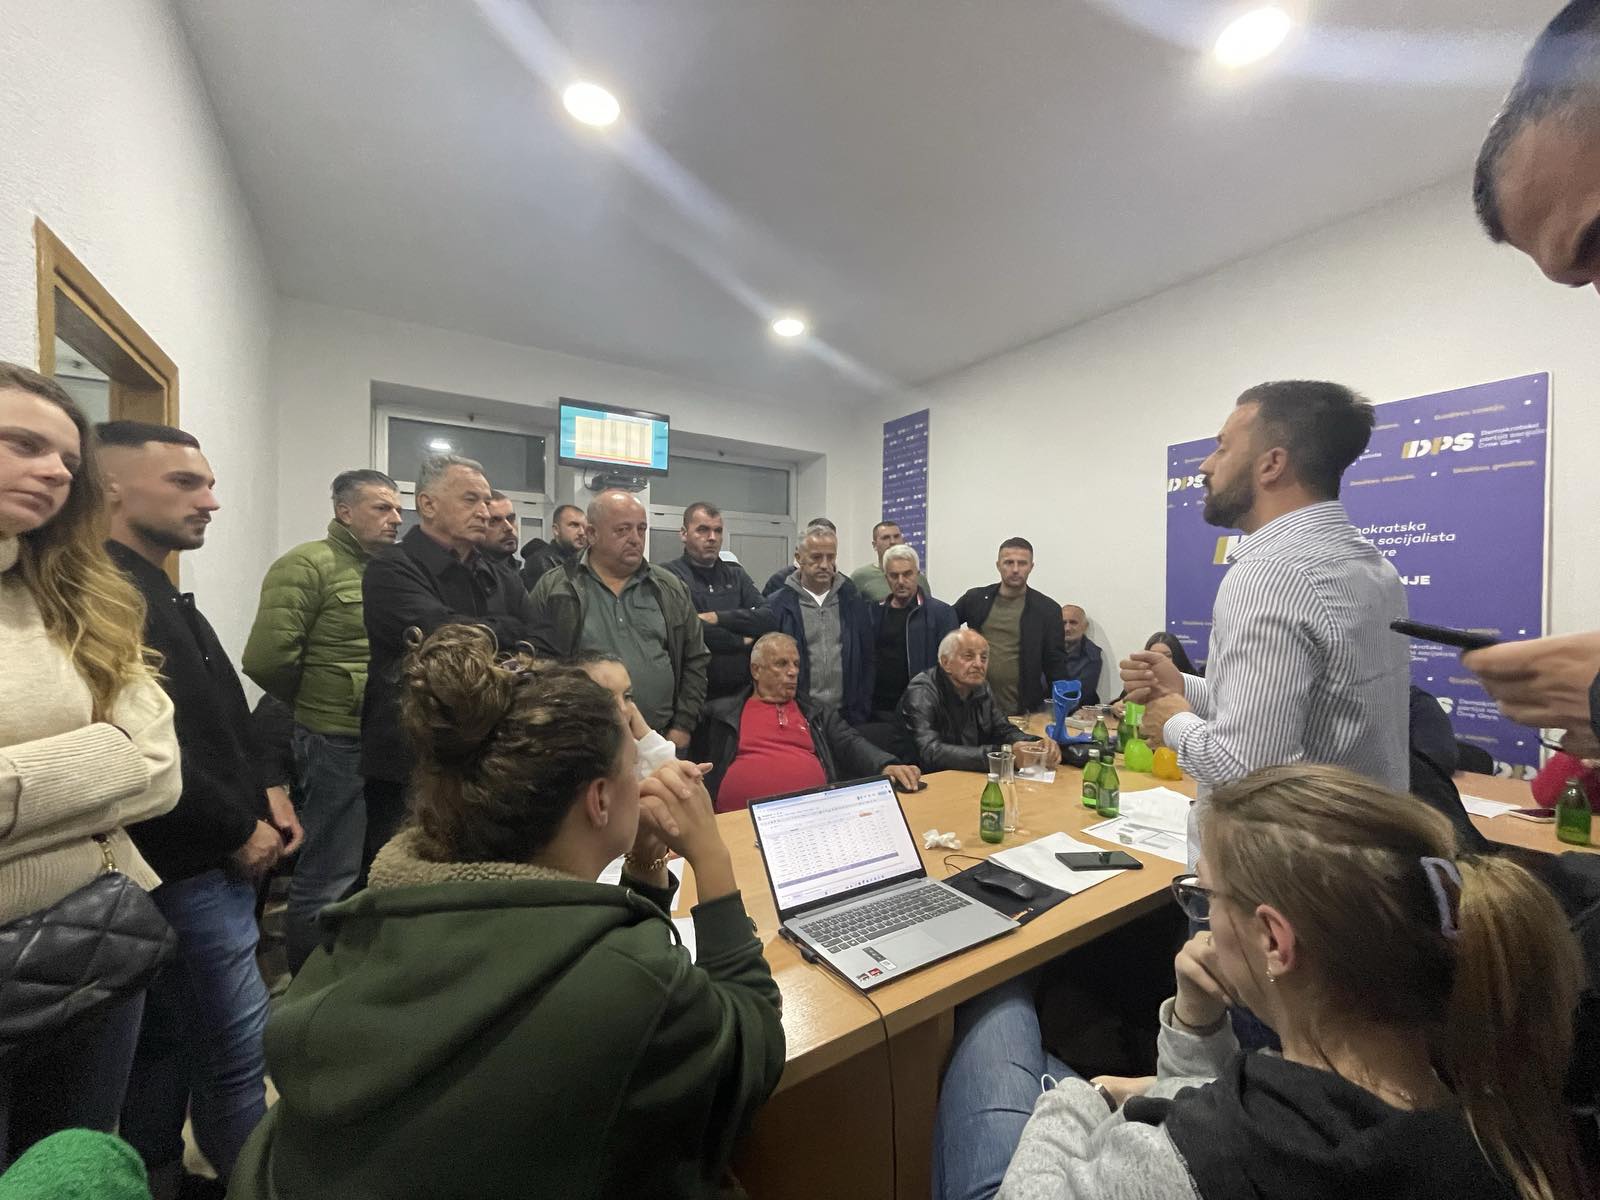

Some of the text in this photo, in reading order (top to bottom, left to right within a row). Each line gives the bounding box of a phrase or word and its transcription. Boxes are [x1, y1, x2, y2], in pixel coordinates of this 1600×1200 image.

[1401, 432, 1476, 459] DPS
[1167, 474, 1207, 492] DPS
[1358, 521, 1426, 535] okratska
[1378, 532, 1456, 546] socijalista
[1400, 575, 1431, 585] NJE
